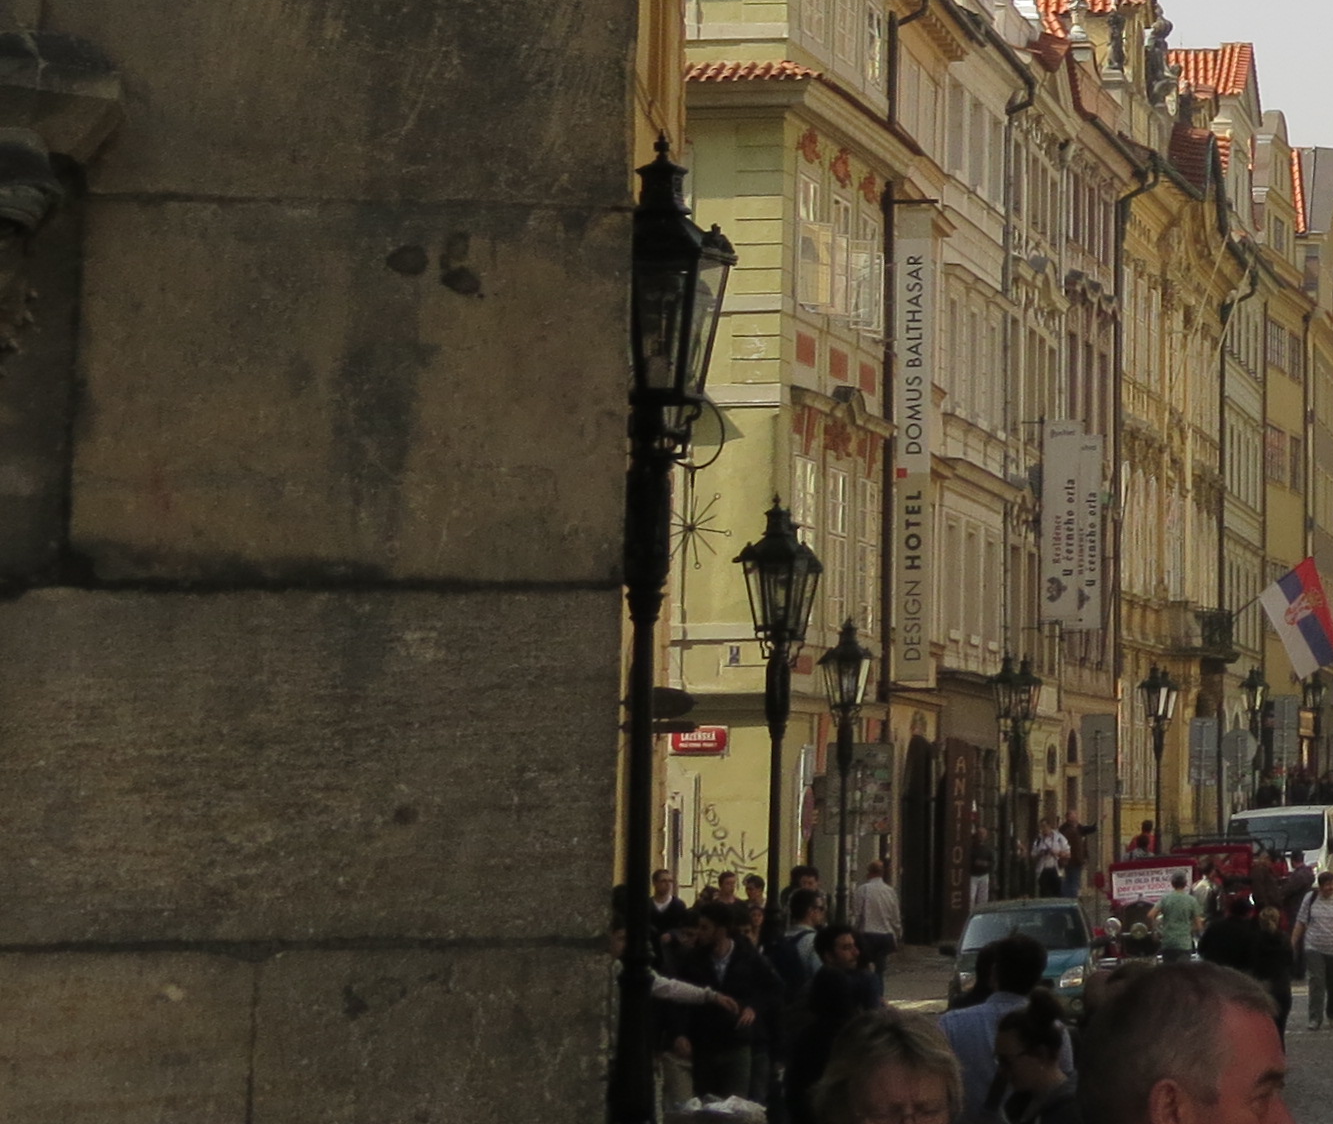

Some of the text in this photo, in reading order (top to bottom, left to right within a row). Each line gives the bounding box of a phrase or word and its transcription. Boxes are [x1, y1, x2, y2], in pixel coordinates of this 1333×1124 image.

[905, 254, 924, 456] DOMUS BALTHASAR
[1061, 478, 1075, 504] orla
[1085, 491, 1098, 517] orla
[904, 489, 922, 661] DESIGN HOTEL
[1062, 568, 1073, 577] U
